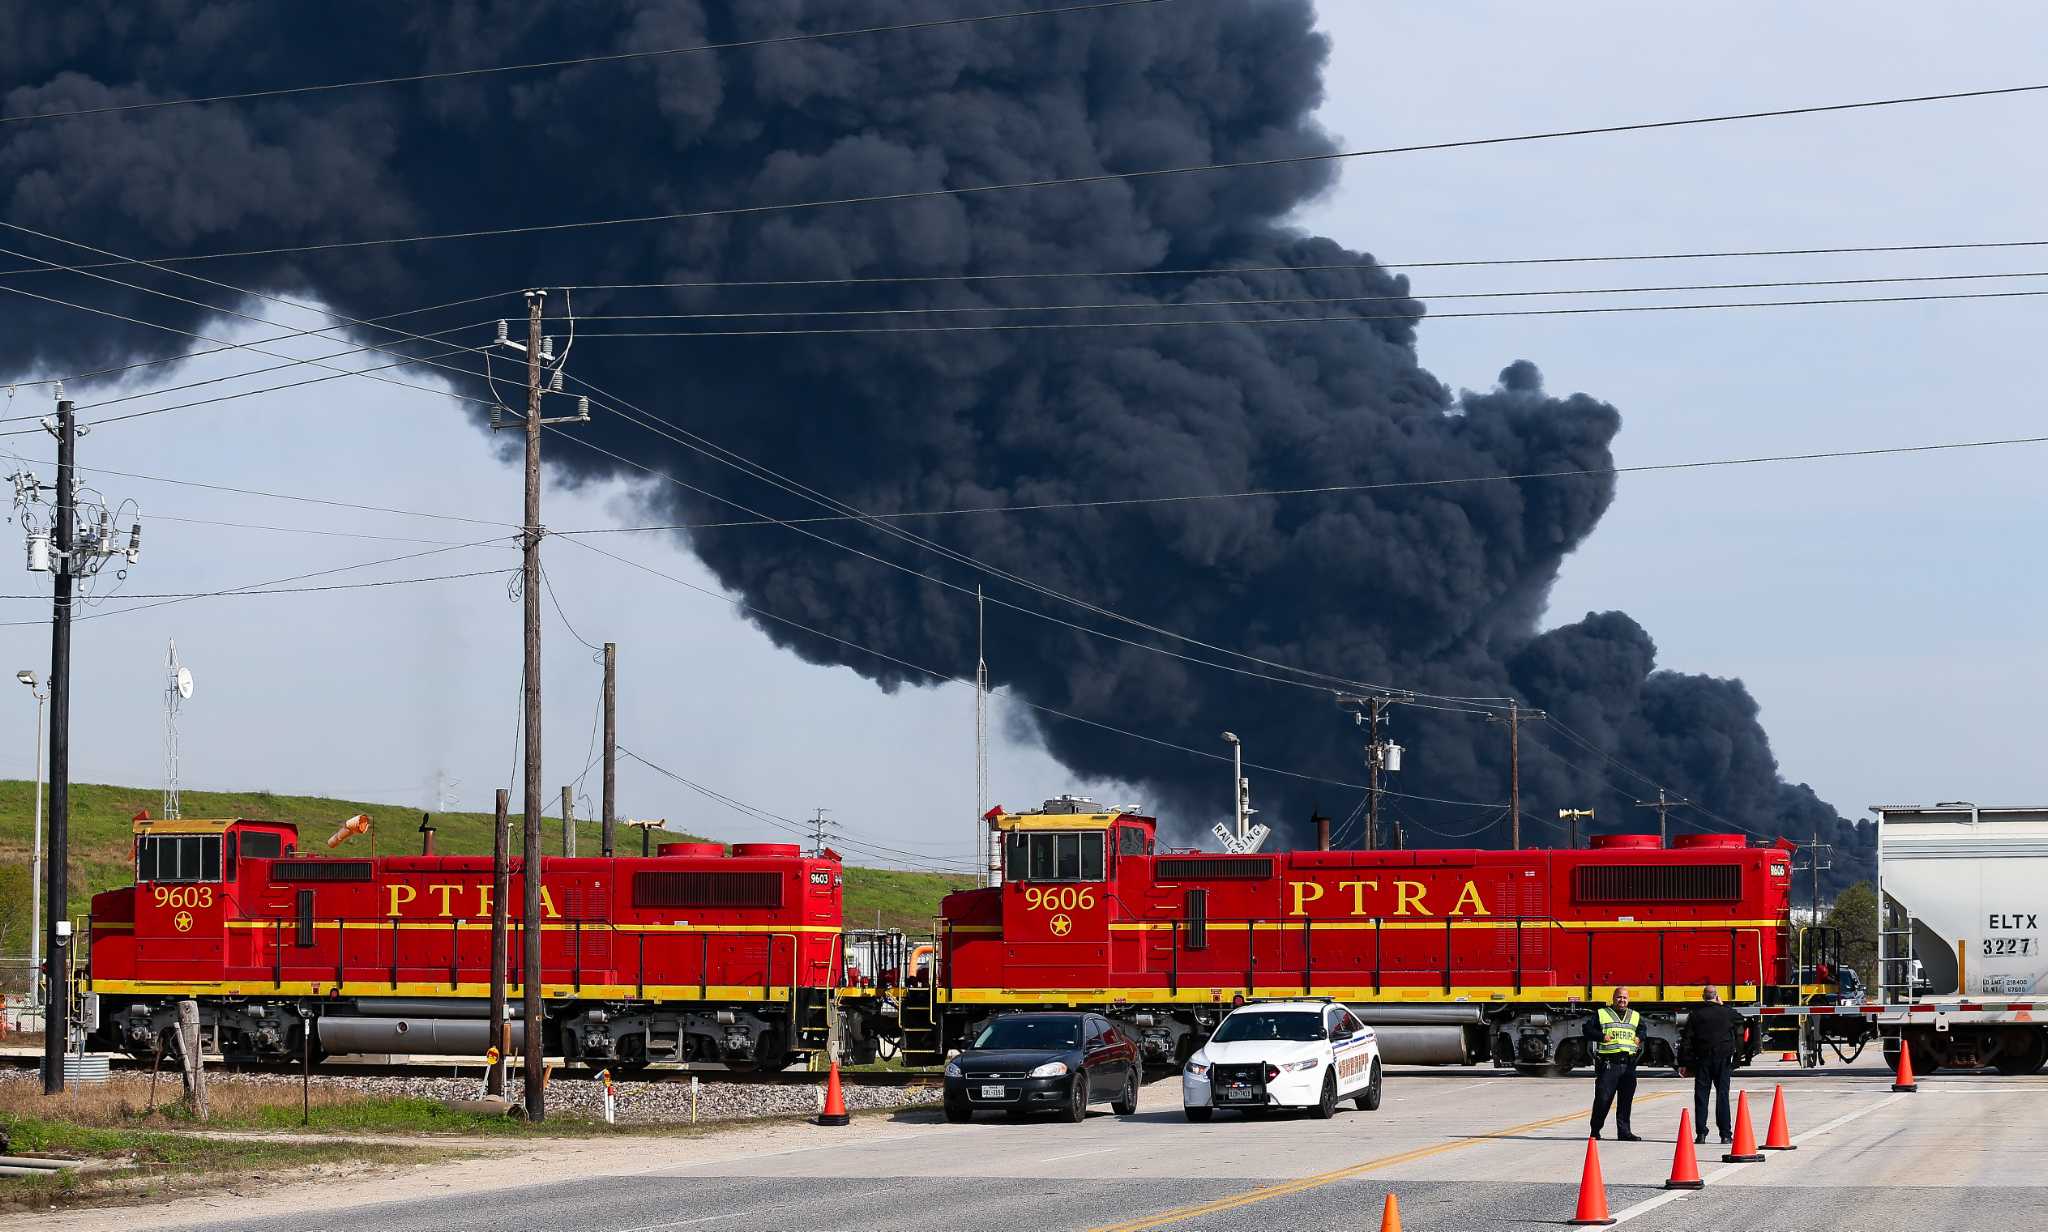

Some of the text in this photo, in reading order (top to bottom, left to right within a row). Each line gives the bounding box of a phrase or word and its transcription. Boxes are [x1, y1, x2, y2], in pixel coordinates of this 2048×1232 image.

[1214, 825, 1234, 849] RAIL
[1231, 828, 1261, 854] SSING
[810, 873, 829, 885] 9603
[154, 886, 213, 908] 9603
[1025, 886, 1095, 911] 9606
[1288, 880, 1491, 916] PTRA
[1989, 914, 2038, 929] ELTX
[1983, 938, 2030, 955] 3227
[1338, 1052, 1369, 1079] SHERIFF
